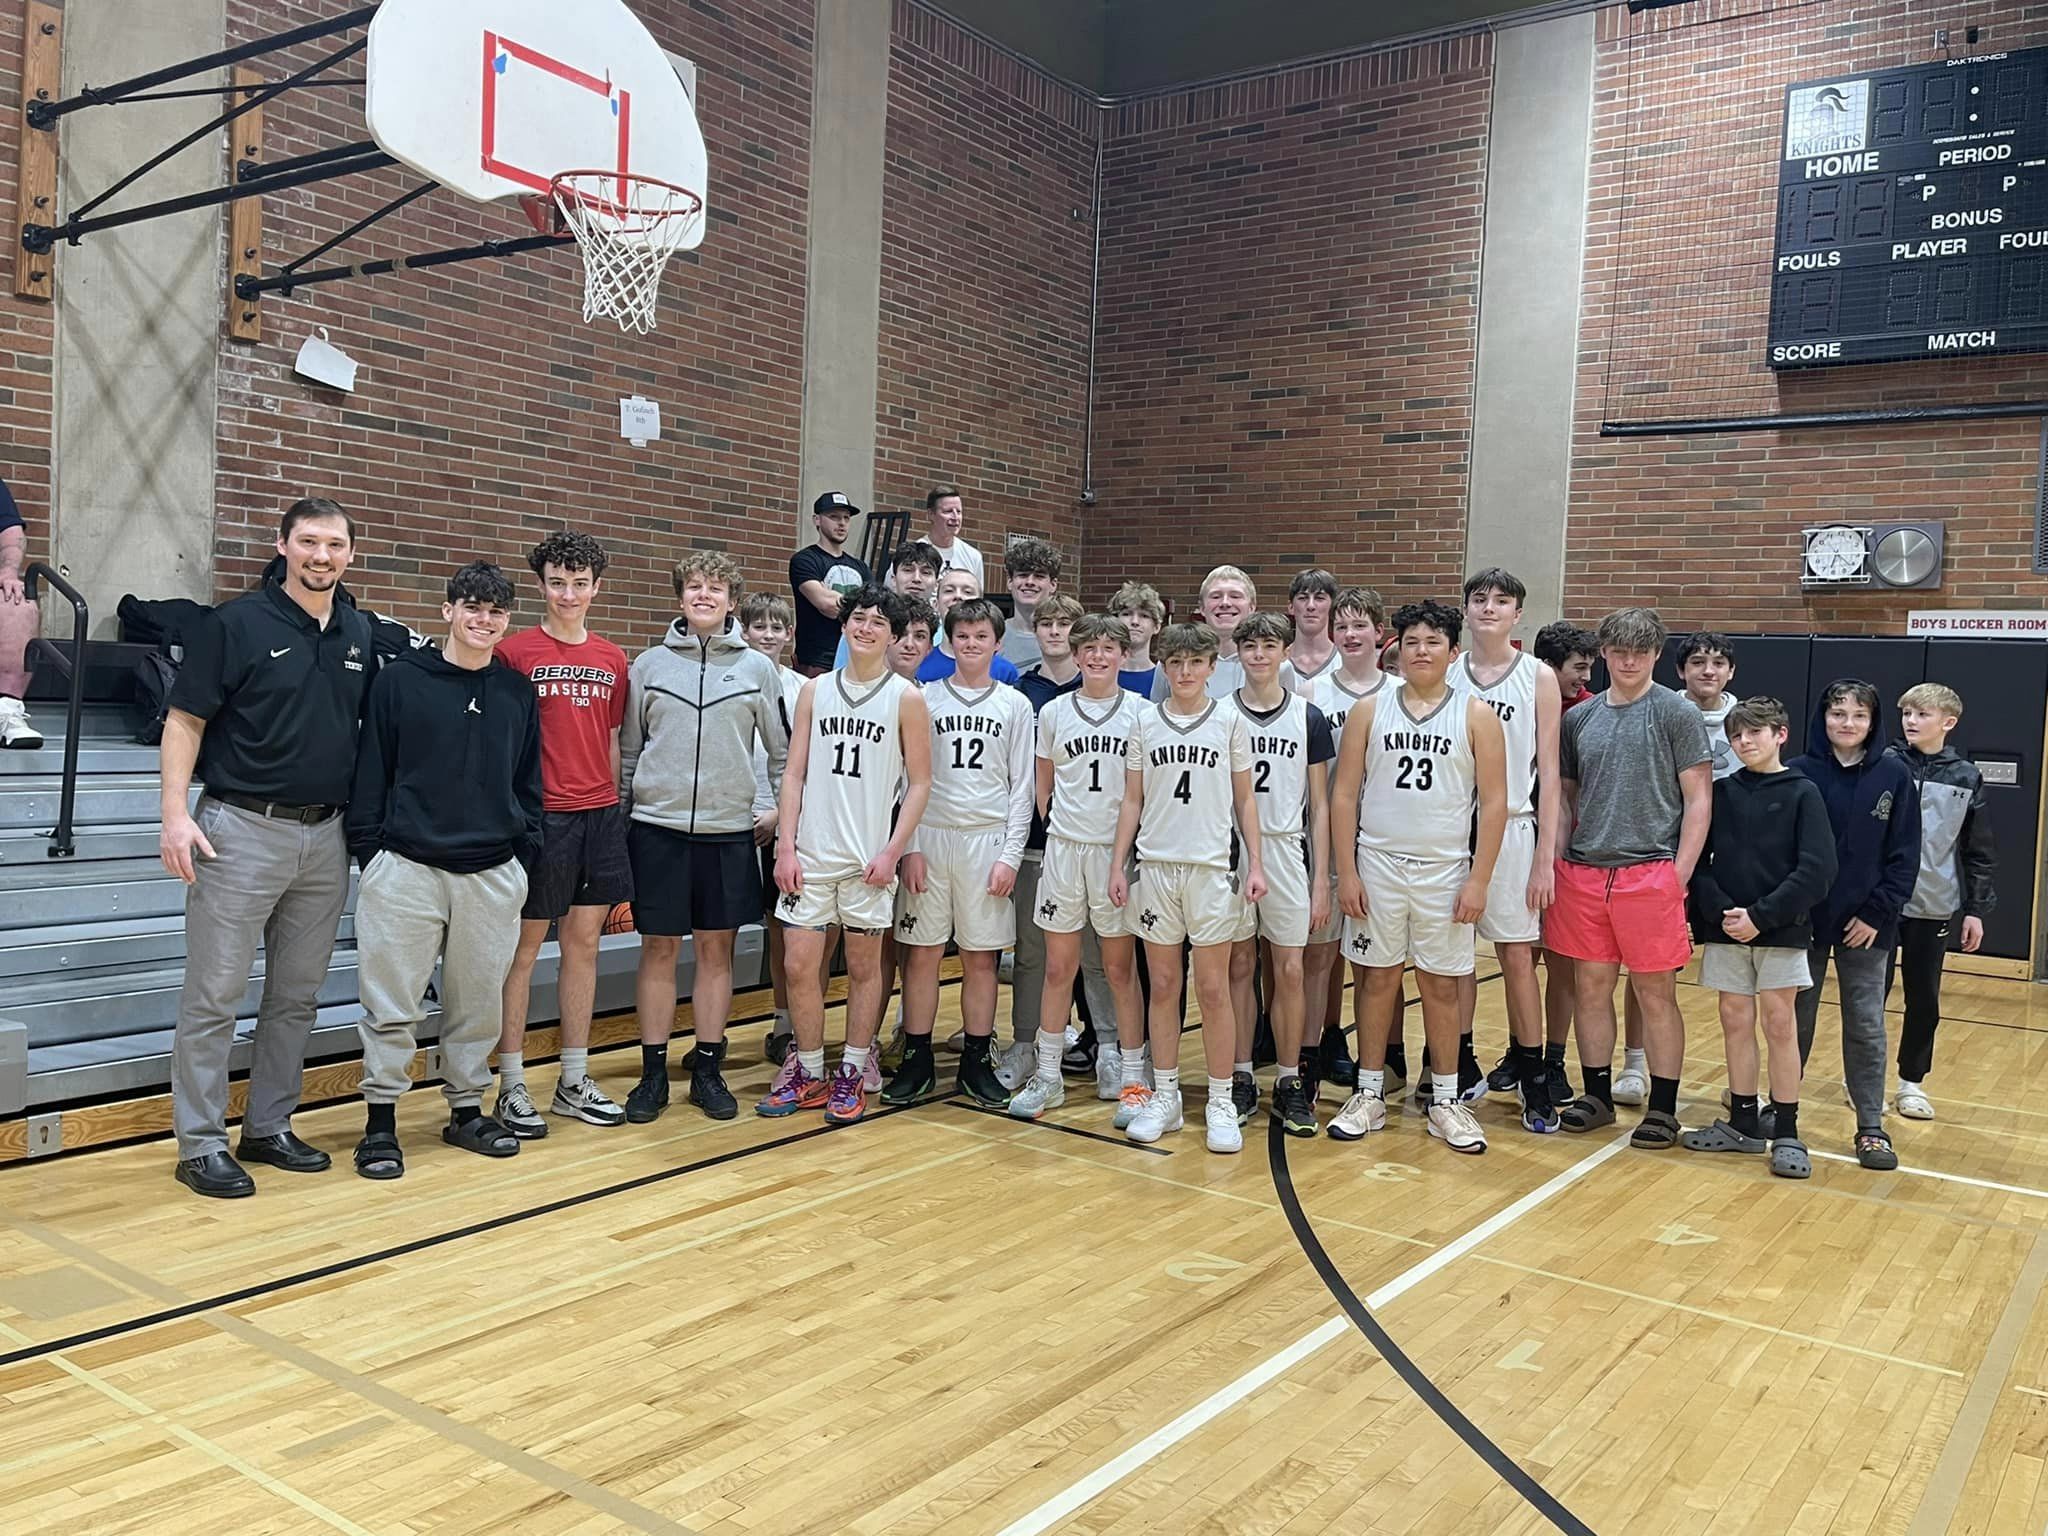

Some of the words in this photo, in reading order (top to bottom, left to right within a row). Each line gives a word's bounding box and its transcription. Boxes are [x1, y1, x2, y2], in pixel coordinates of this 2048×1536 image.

[1946, 52, 2008, 67] DAKTRONICS
[1791, 133, 1861, 157] KNIGHTS
[1939, 144, 2011, 166] PERIOD
[1805, 152, 1880, 179] HOME
[1922, 185, 1937, 201] P
[2003, 175, 2017, 192] P
[1931, 208, 2003, 230] BONUS
[1892, 238, 1967, 260] PLAYER
[1778, 251, 1841, 272] FOULS
[1772, 342, 1842, 361] SCORE
[1927, 331, 1996, 350] MATCH
[1911, 618, 1947, 630] BOYS
[1951, 618, 2003, 630] LOCKER
[2008, 619, 2046, 630] ROOM
[531, 665, 616, 685] BEAVERS
[819, 716, 885, 743] KNIGHTS
[934, 715, 1002, 738] KNIGHTS
[951, 737, 984, 770] 12
[1065, 735, 1128, 759] KNIGHTS
[1384, 732, 1451, 755] KNIGHTS
[832, 742, 862, 778] 11
[1150, 745, 1219, 768] KNIGHTS
[1089, 759, 1102, 792] 1
[1255, 760, 1271, 793] 2
[1396, 756, 1433, 791] 23
[1174, 770, 1191, 805] 4
